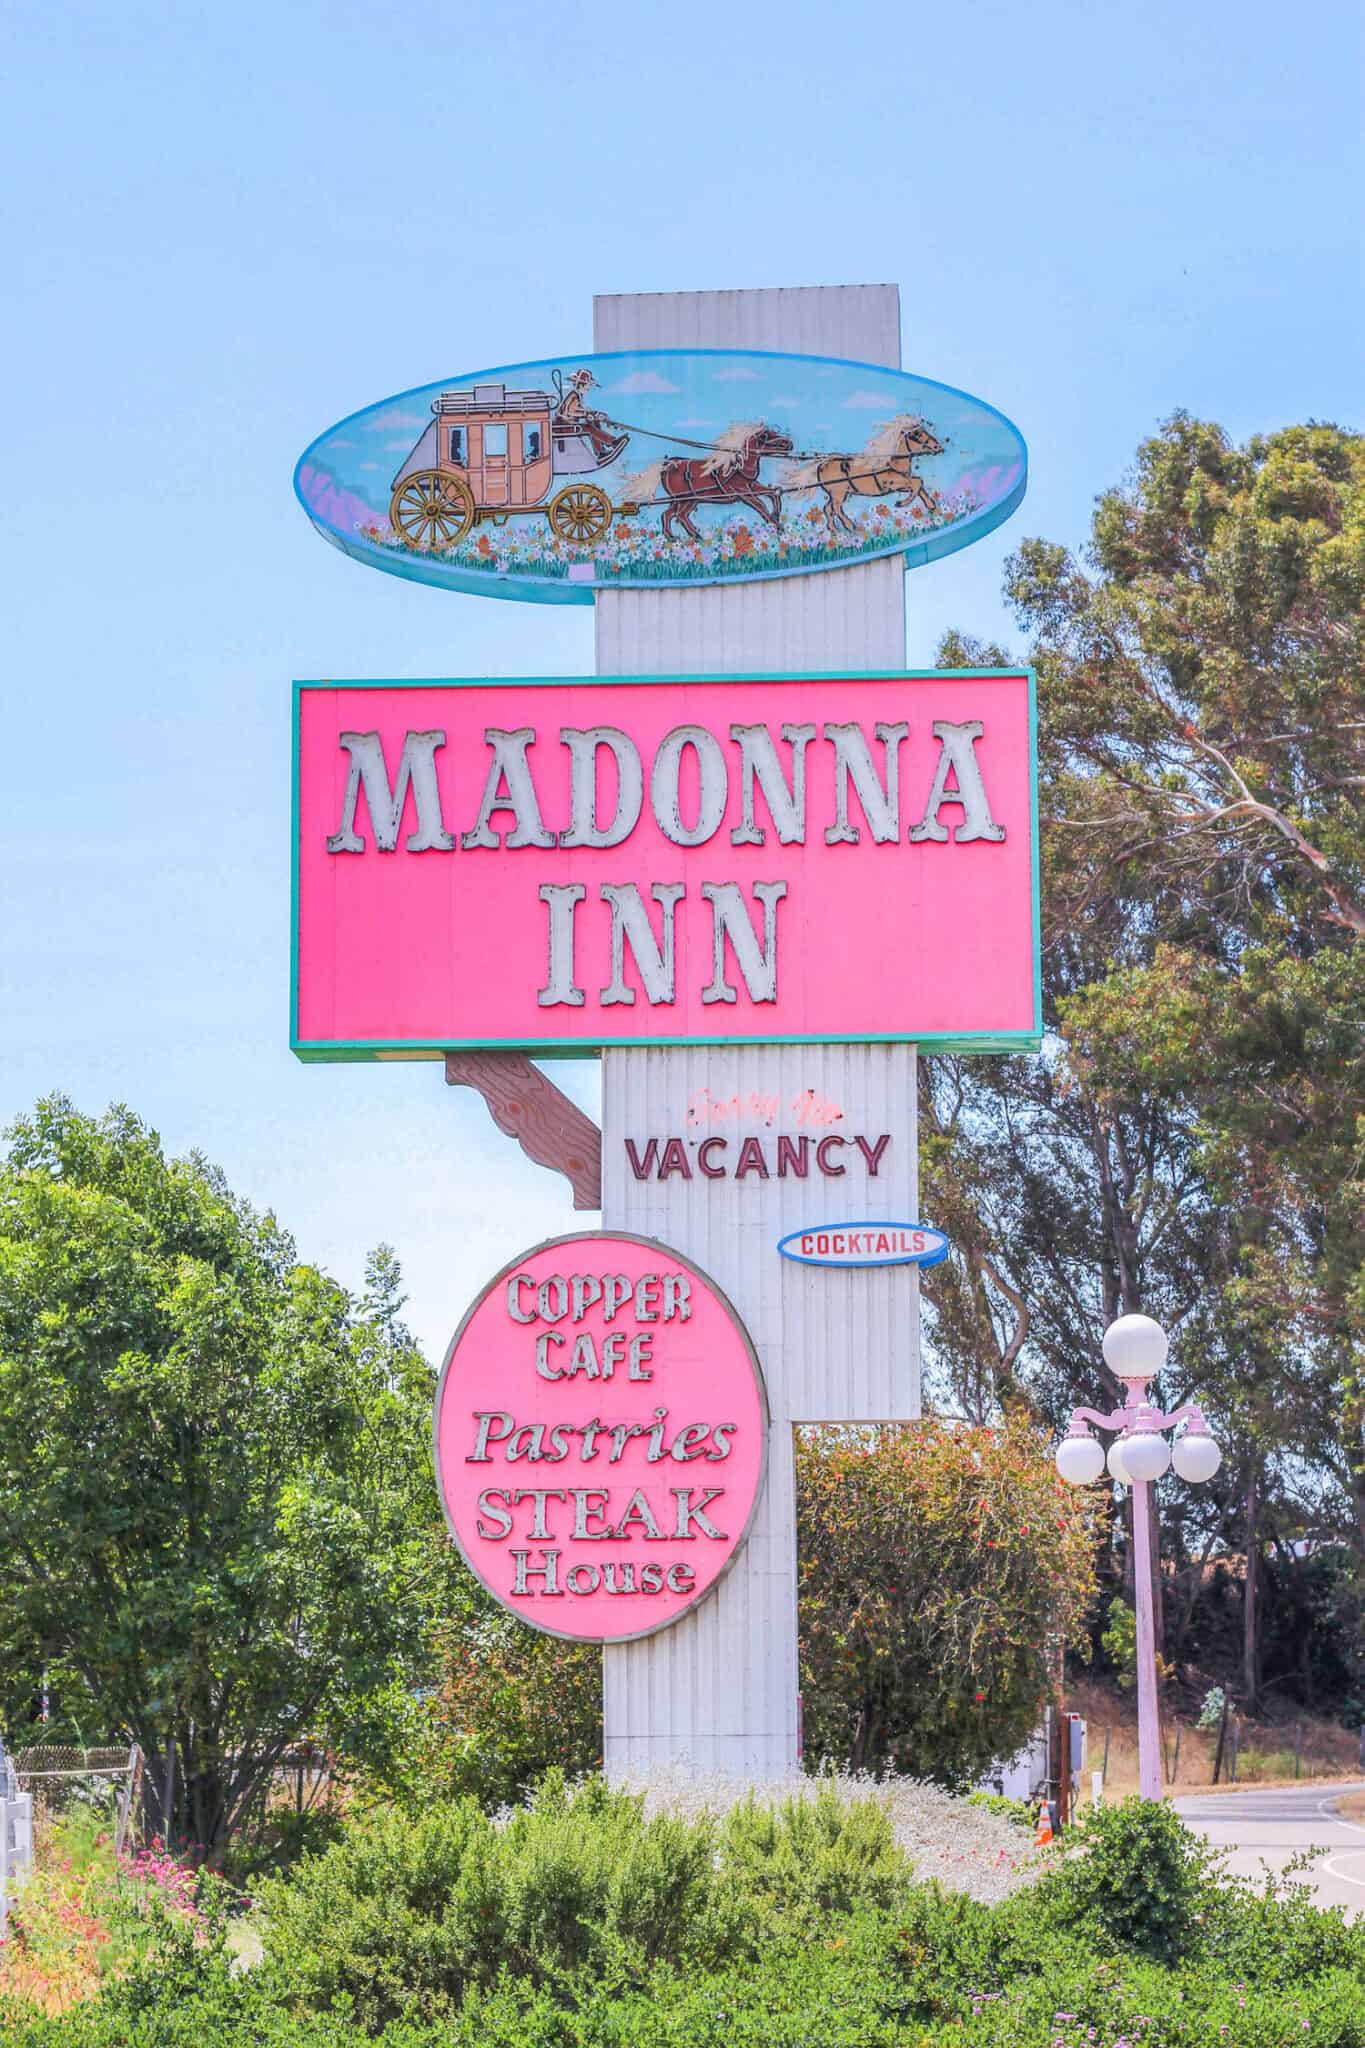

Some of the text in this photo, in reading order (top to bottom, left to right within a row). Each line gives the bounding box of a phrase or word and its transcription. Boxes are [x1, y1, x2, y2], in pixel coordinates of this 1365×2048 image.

[326, 719, 1007, 854] MADONNA
[537, 880, 788, 1007] INN
[624, 1134, 891, 1179] VACANCY
[801, 1231, 925, 1255] COCKTAILS
[507, 1273, 692, 1324] COPPER
[535, 1330, 654, 1381] CAFE
[465, 1407, 737, 1464] Pastries
[476, 1488, 728, 1541] STEAK
[508, 1549, 696, 1596] House
